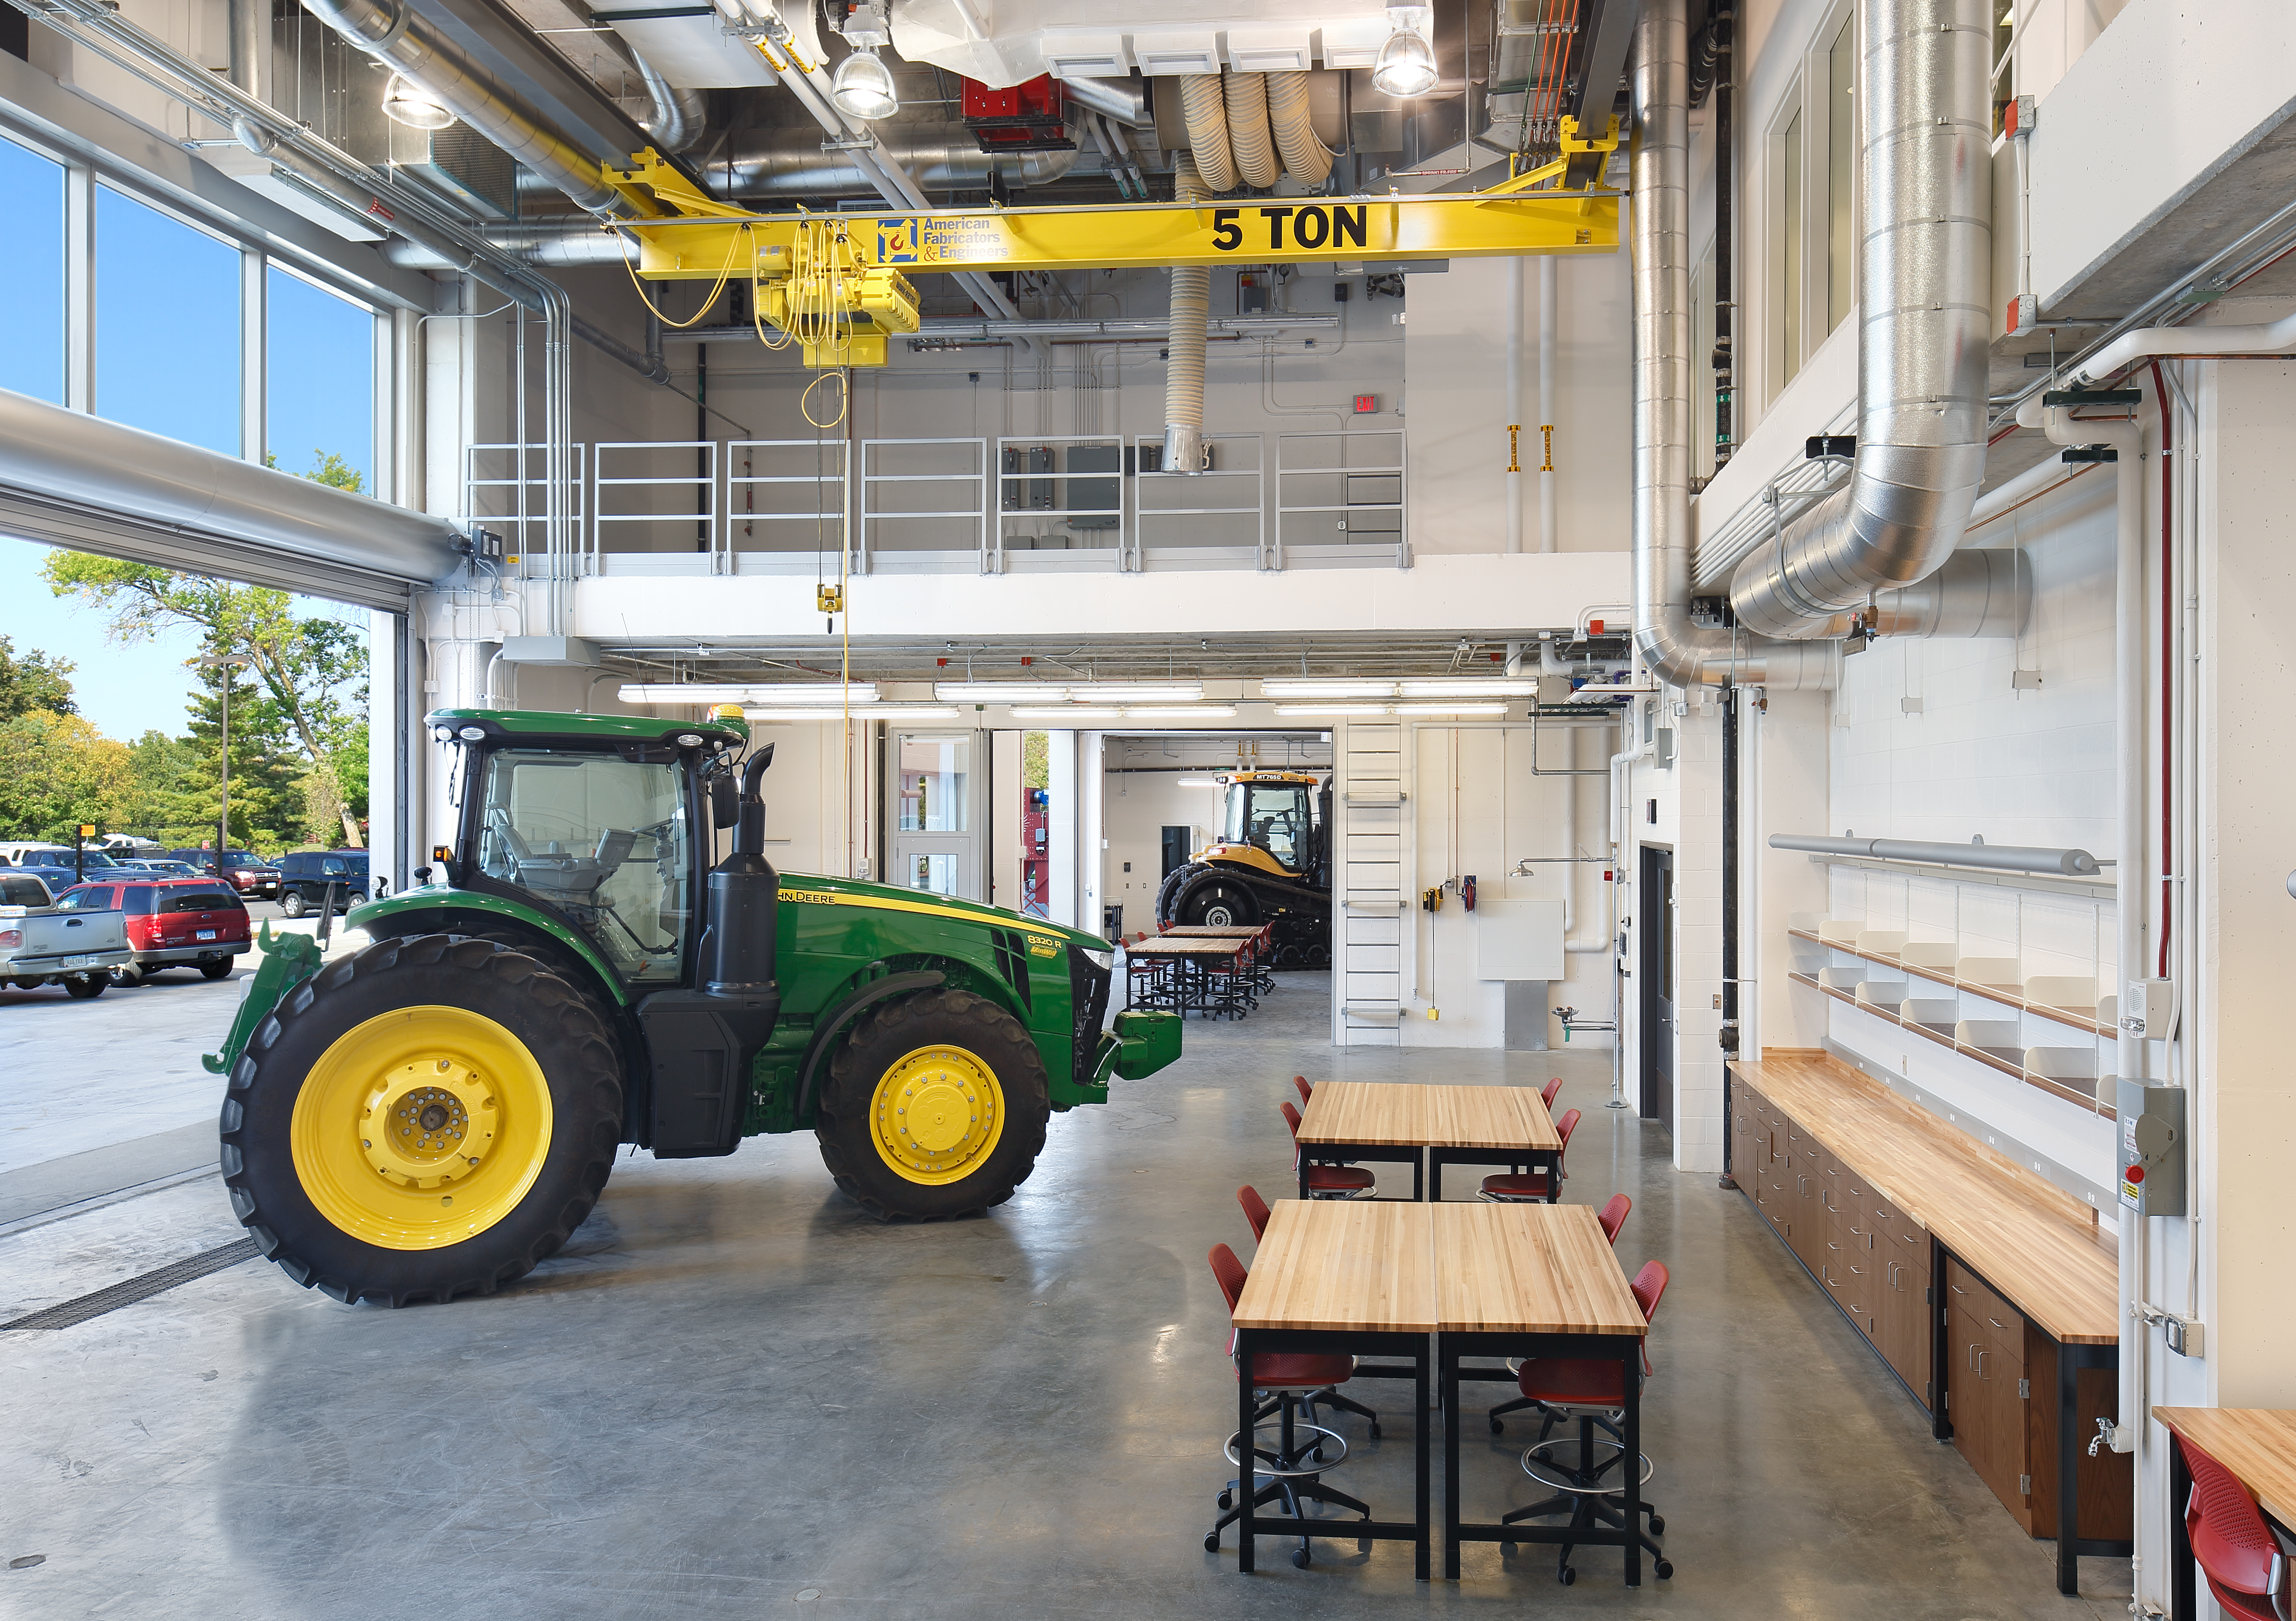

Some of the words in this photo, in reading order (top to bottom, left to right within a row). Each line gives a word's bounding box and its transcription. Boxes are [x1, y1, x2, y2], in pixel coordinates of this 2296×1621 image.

[923, 217, 990, 230] American
[1211, 208, 1243, 251] 5
[1260, 205, 1367, 249] TON
[923, 231, 1000, 244] Fabricators
[923, 246, 938, 261] &
[939, 245, 1009, 260] Engineers
[896, 280, 916, 305] WORK-RATED
[1357, 396, 1375, 412] EXIT
[778, 892, 793, 901] HN
[796, 892, 836, 904] DEERE
[1027, 935, 1053, 946] 8320
[1055, 940, 1062, 948] R
